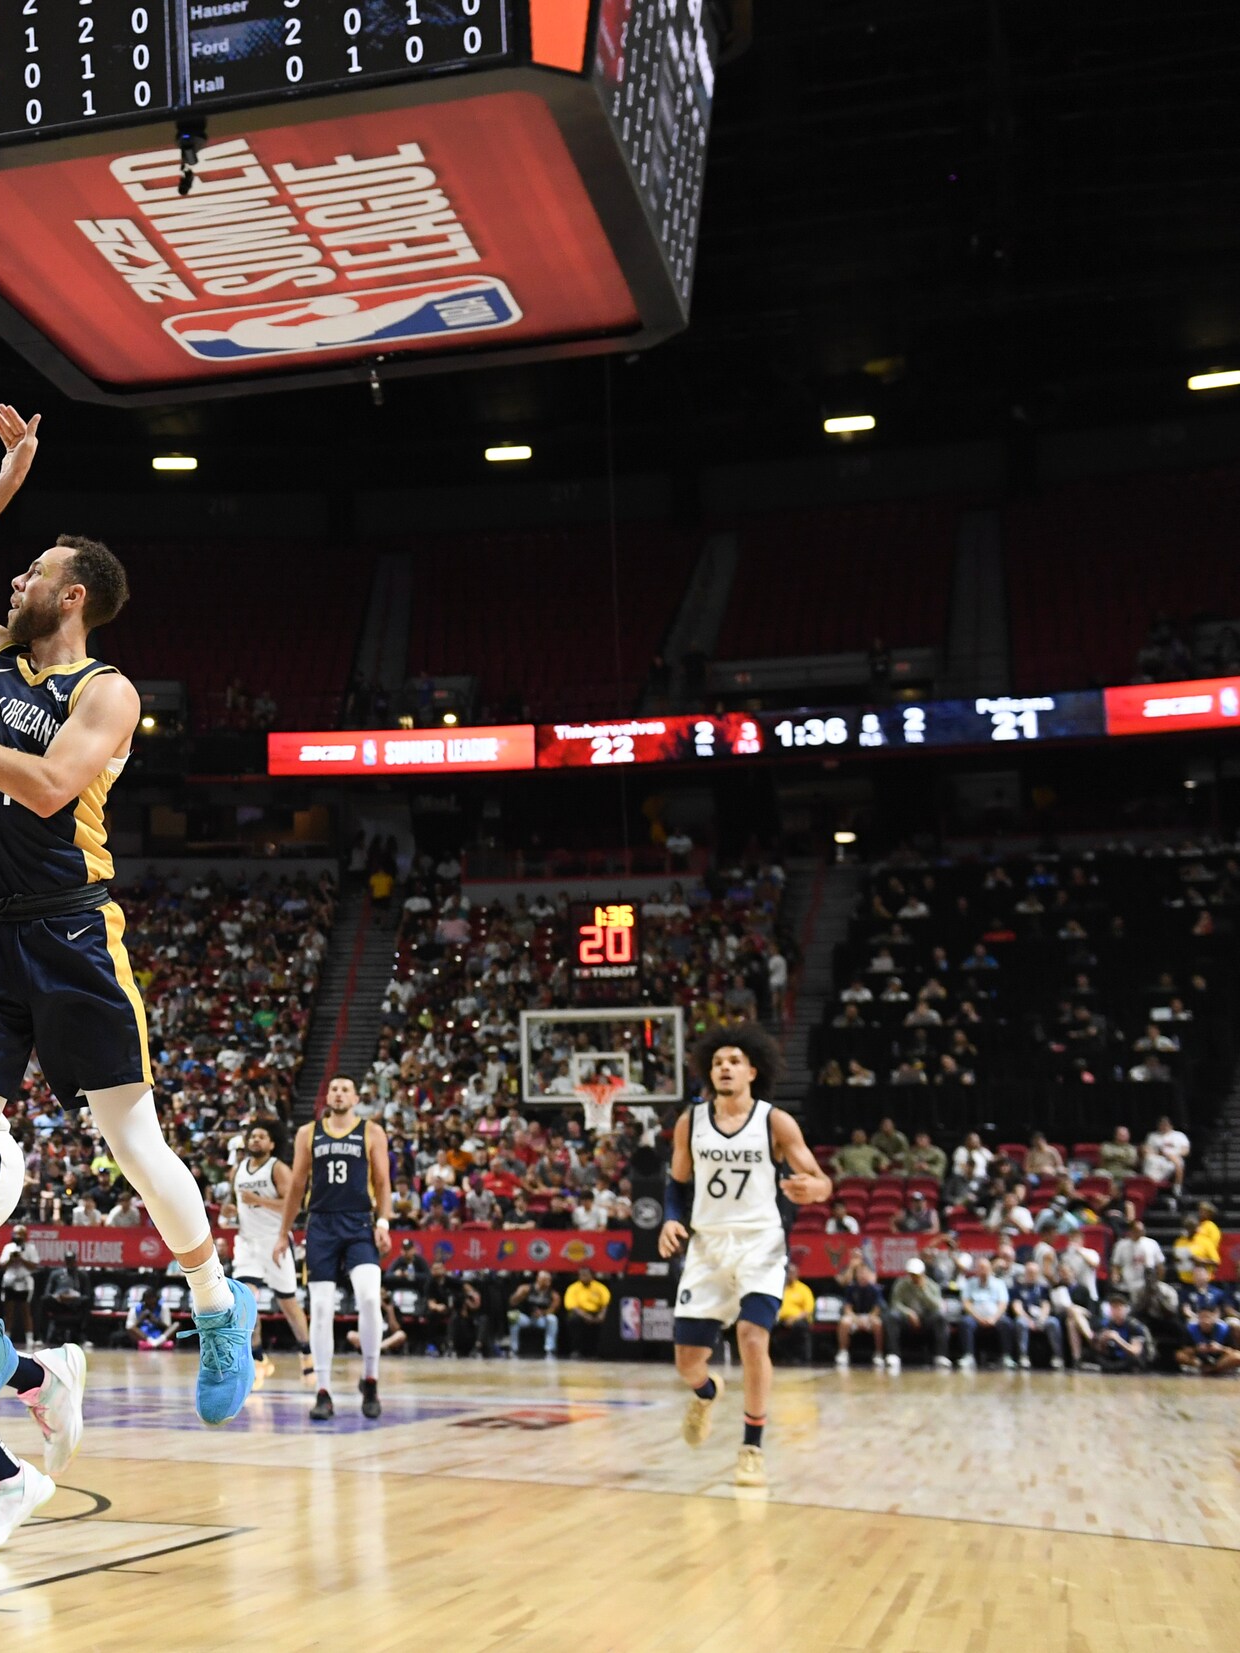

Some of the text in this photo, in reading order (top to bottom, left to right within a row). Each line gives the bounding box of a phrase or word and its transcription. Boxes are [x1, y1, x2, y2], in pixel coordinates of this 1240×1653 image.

[190, 0, 249, 21] Hauser
[24, 27, 39, 53] 1
[78, 17, 94, 44] 2
[131, 8, 148, 34] 0
[192, 37, 229, 58] Ford
[284, 18, 303, 46] 2
[343, 7, 362, 35] 0
[406, 0, 421, 26] 1
[24, 63, 41, 89] 0
[81, 53, 96, 80] 1
[132, 44, 150, 71] 0
[193, 26, 482, 95] Hall 0 1 0 0
[25, 99, 42, 125] 0
[82, 90, 97, 116] 1
[134, 81, 151, 107] 0
[108, 138, 337, 296] SUMMER
[272, 142, 481, 281] LEAGUE
[74, 218, 198, 303] 2K25
[433, 295, 498, 327] NBA
[553, 721, 666, 741] Timberwolves
[694, 721, 715, 745] 2
[740, 722, 758, 740] 3
[774, 717, 848, 748] 1:36
[902, 707, 926, 731] 2
[991, 710, 1039, 741] 21
[384, 740, 445, 766] SUMMER
[590, 735, 635, 764] 22
[594, 904, 635, 928] 1:36
[579, 925, 632, 964] 20
[591, 965, 638, 978] TISSOT
[314, 1143, 362, 1158] NEW ORLEANS
[698, 1149, 763, 1163] WOLVES
[327, 1160, 348, 1184] 13
[707, 1168, 752, 1201] 67
[81, 1241, 124, 1263] LEAGUE
